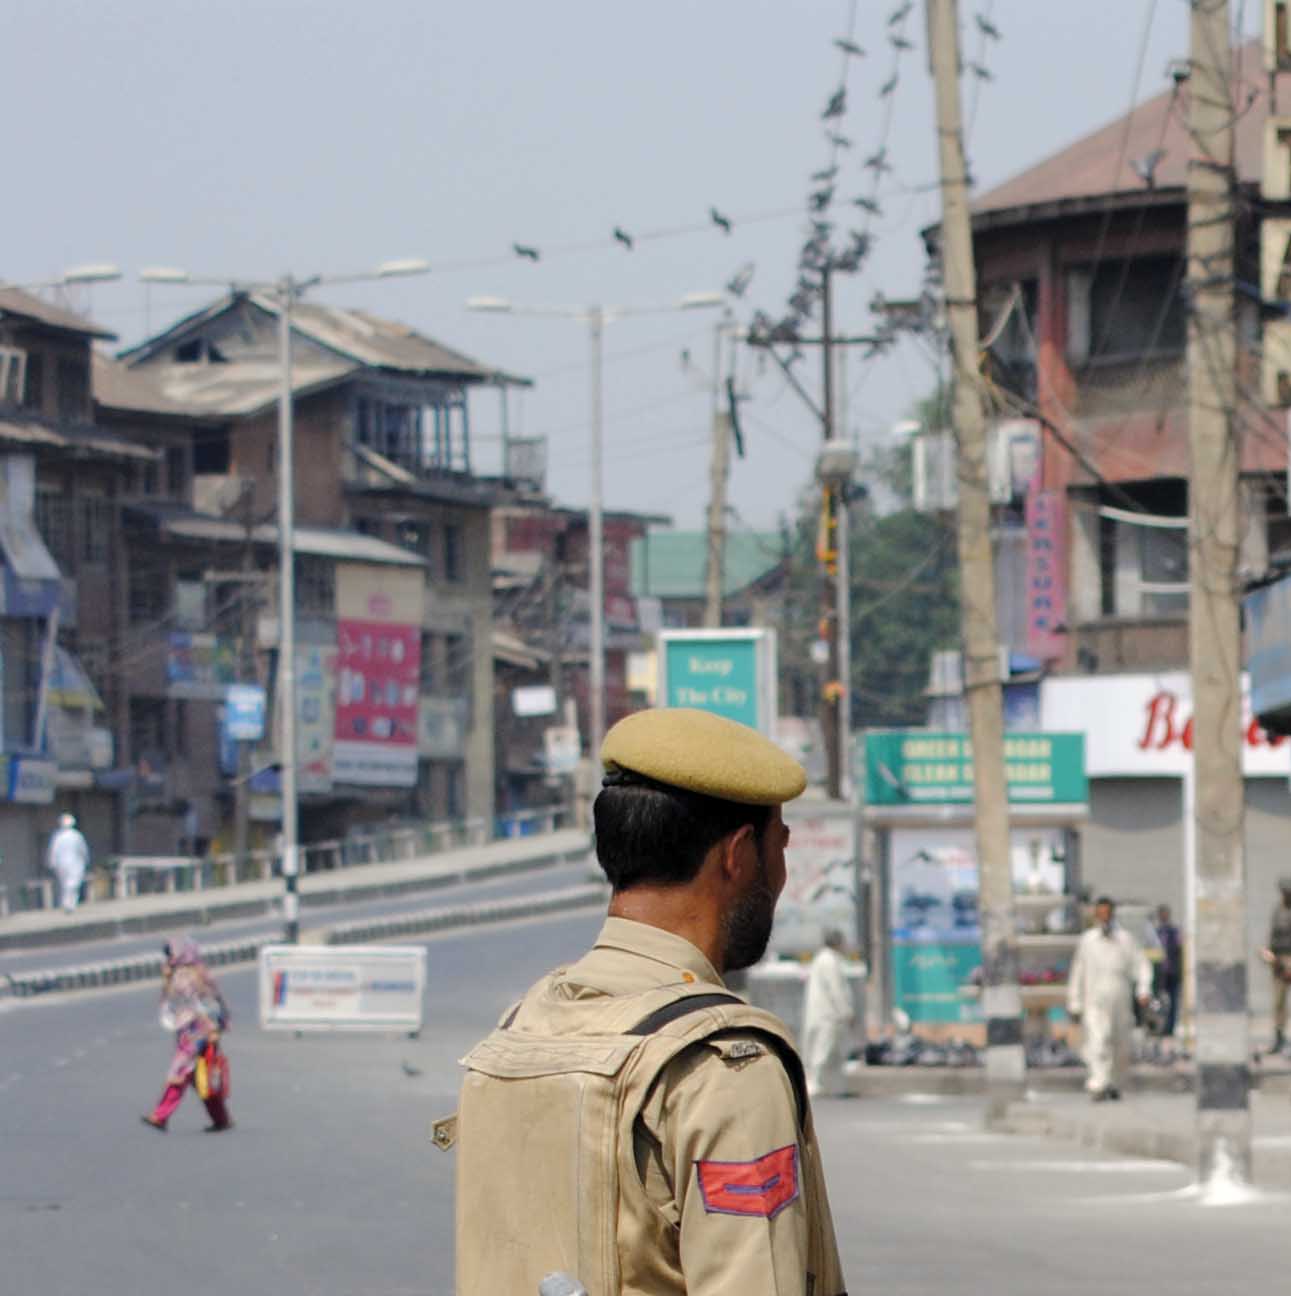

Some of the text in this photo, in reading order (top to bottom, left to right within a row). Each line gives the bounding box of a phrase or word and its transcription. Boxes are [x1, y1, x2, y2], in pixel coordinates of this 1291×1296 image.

[689, 656, 733, 677] Keep
[677, 687, 748, 708] The City
